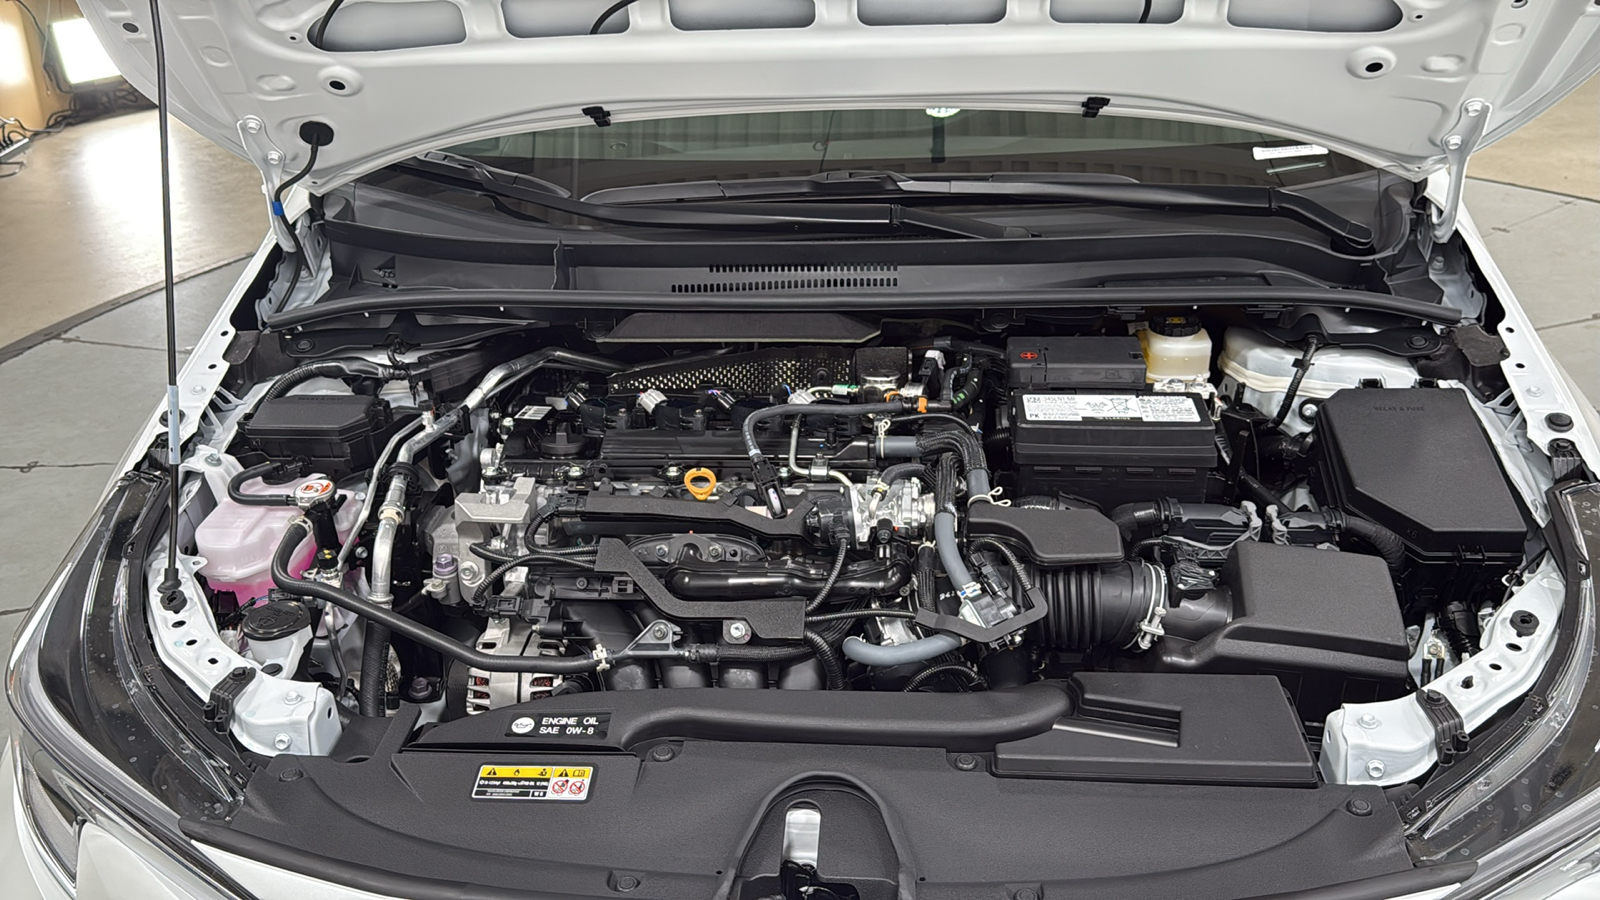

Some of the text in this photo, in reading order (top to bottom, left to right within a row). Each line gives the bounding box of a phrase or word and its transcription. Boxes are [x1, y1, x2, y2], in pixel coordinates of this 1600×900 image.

[541, 717, 599, 725] ENGINE OIL
[539, 726, 594, 735] SAE 0W-8
